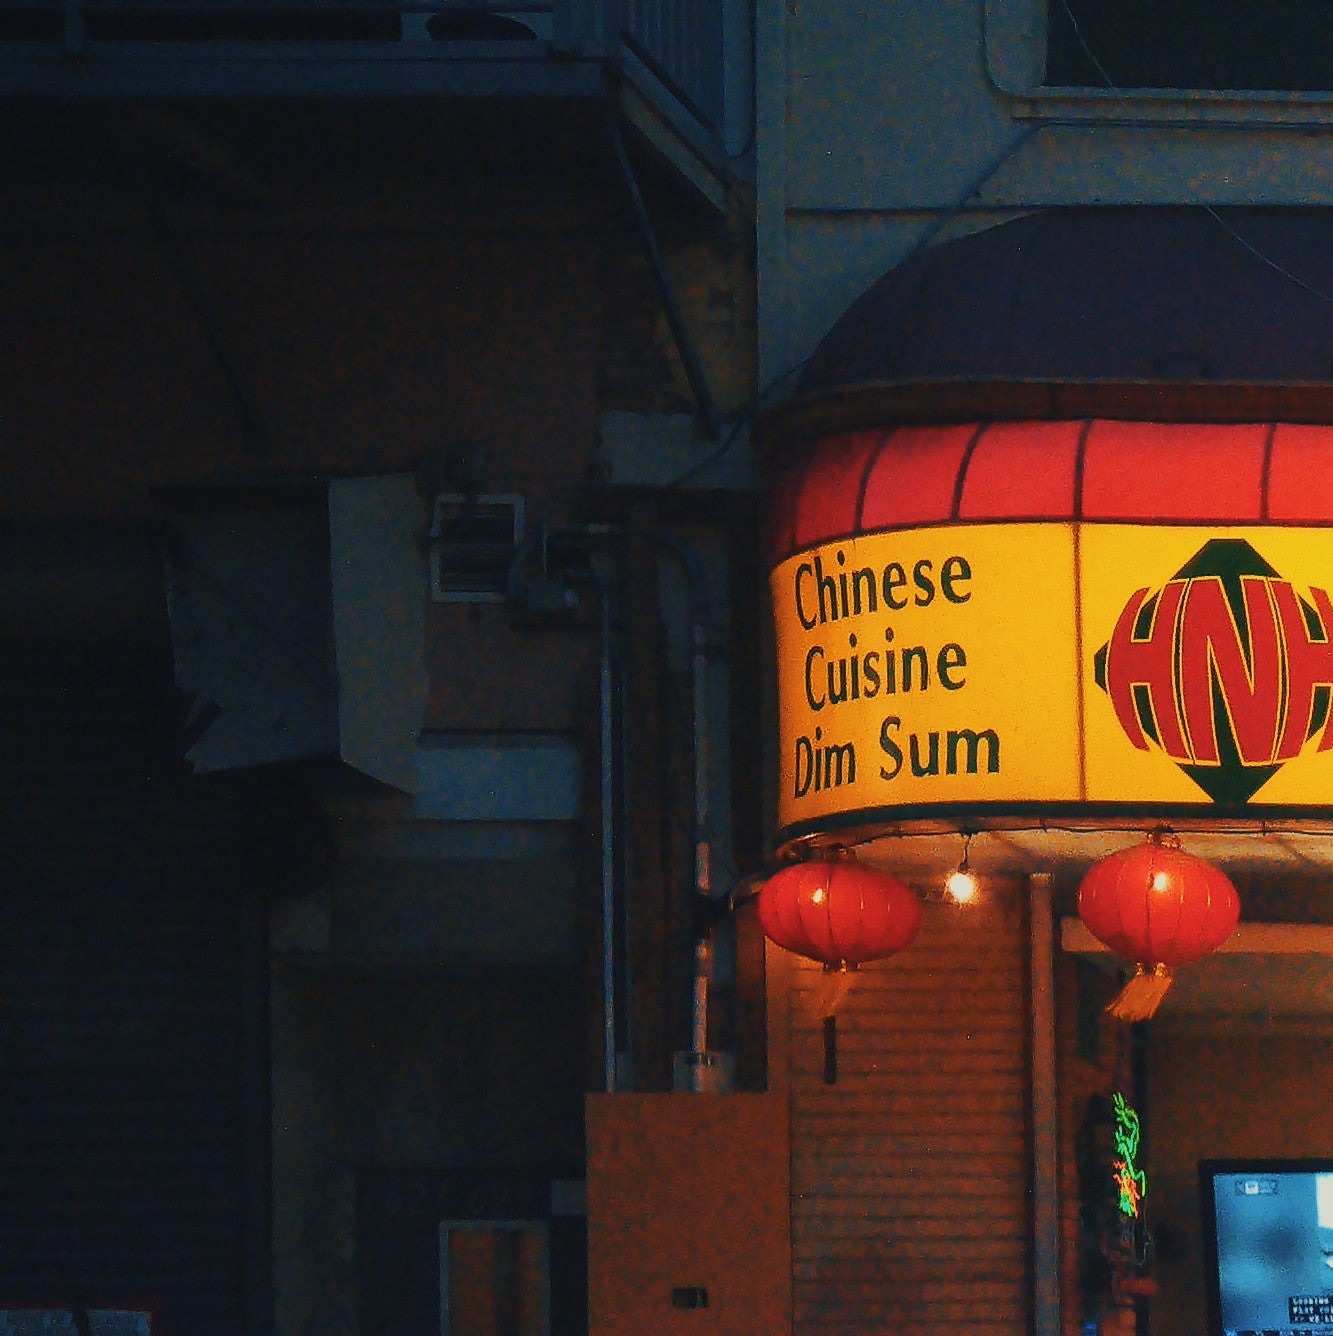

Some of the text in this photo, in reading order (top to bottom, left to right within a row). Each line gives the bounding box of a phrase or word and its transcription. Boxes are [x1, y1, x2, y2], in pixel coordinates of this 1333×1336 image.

[795, 553, 972, 630] Chinese
[805, 627, 967, 711] Cuisine
[794, 716, 1000, 798] Dim Sum
